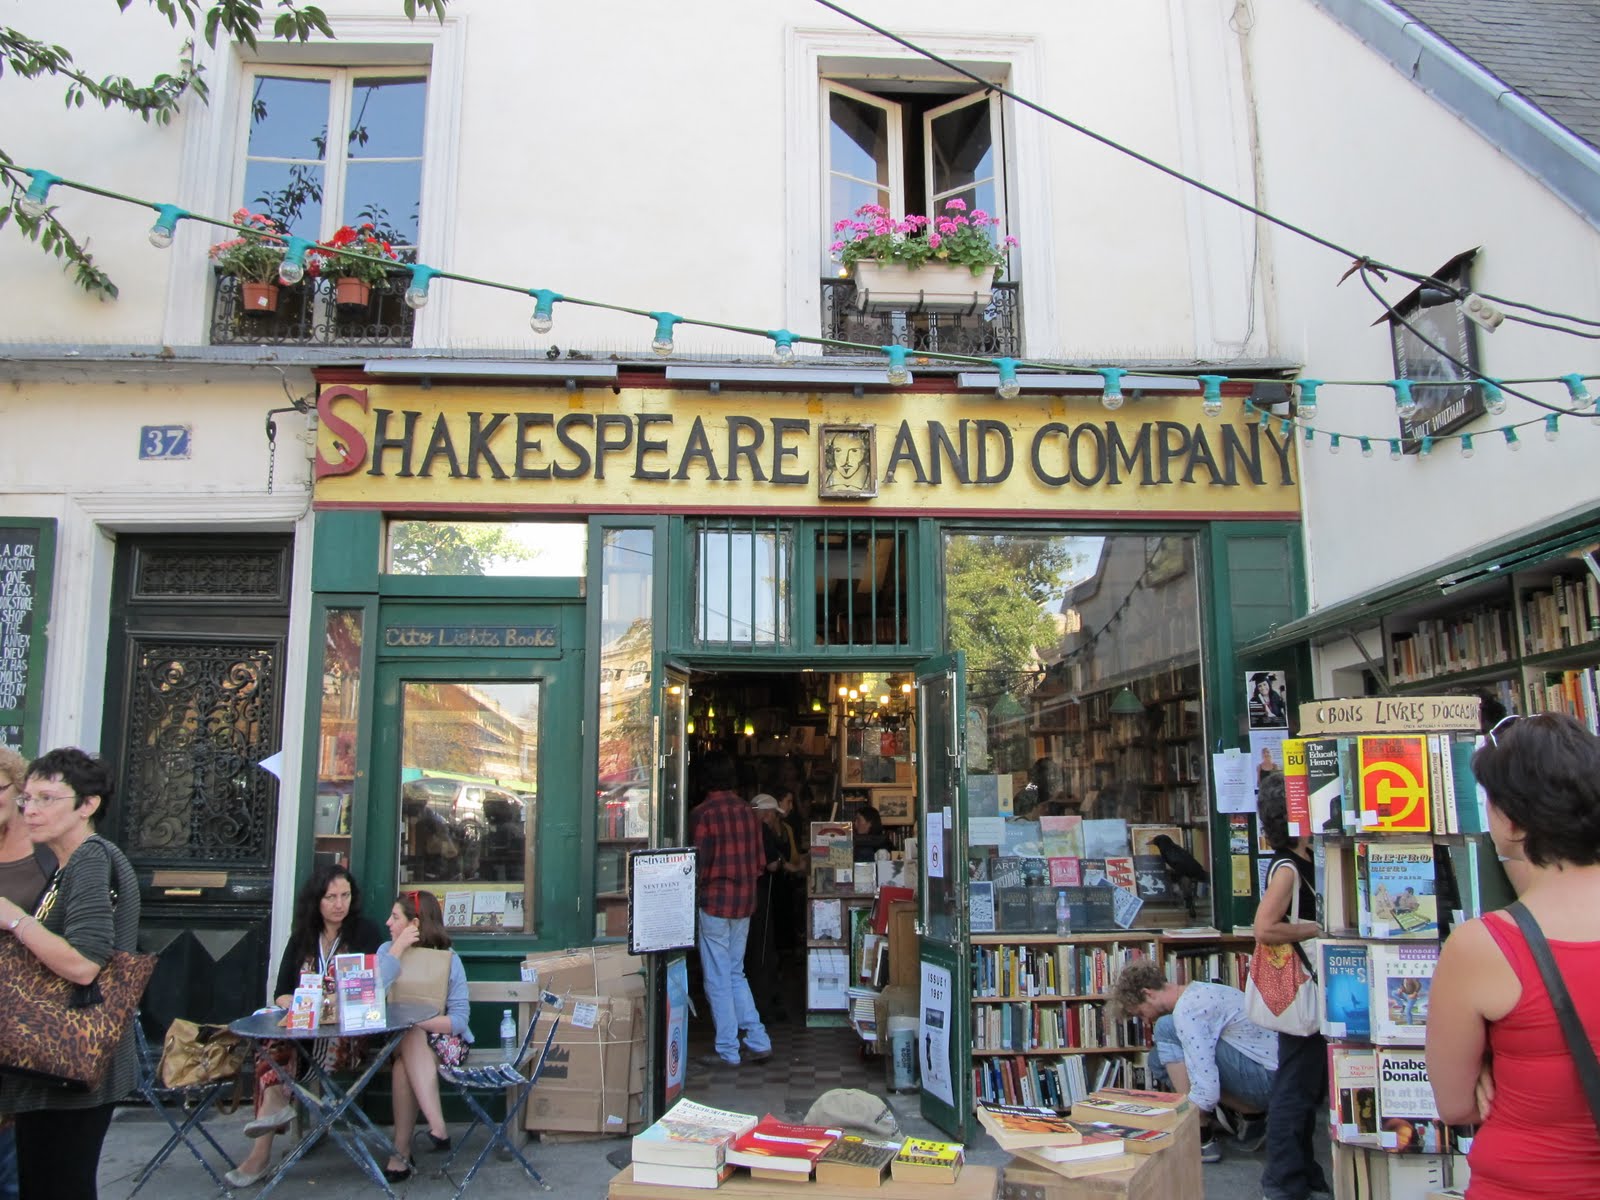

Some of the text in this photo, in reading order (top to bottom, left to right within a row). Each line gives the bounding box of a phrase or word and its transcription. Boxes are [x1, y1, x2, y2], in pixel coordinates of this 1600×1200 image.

[315, 385, 1296, 487] SHAKESPEARE AND COMPANY
[147, 430, 185, 456] 37
[6, 570, 27, 584] ONE
[1, 583, 31, 597] YEARS
[0, 596, 33, 610] OOKSTORE
[1, 608, 26, 623] SHOP
[386, 628, 434, 647] City
[438, 628, 500, 646] Lights
[1328, 705, 1364, 724] BONS
[1376, 701, 1425, 724] LIVRES
[1308, 743, 1324, 751] The
[1288, 755, 1304, 766] BU
[1309, 751, 1337, 759] Educati
[1310, 759, 1333, 767] Henry
[1371, 853, 1432, 863] RETRO
[660, 881, 680, 889] EVENT
[1329, 967, 1338, 975] IN
[1340, 967, 1355, 975] THE
[927, 972, 944, 987] ISSUE
[1382, 1058, 1426, 1070] Anabe
[1384, 1088, 1395, 1098] In
[1398, 1088, 1411, 1098] at
[1384, 1099, 1435, 1111] Deep En
